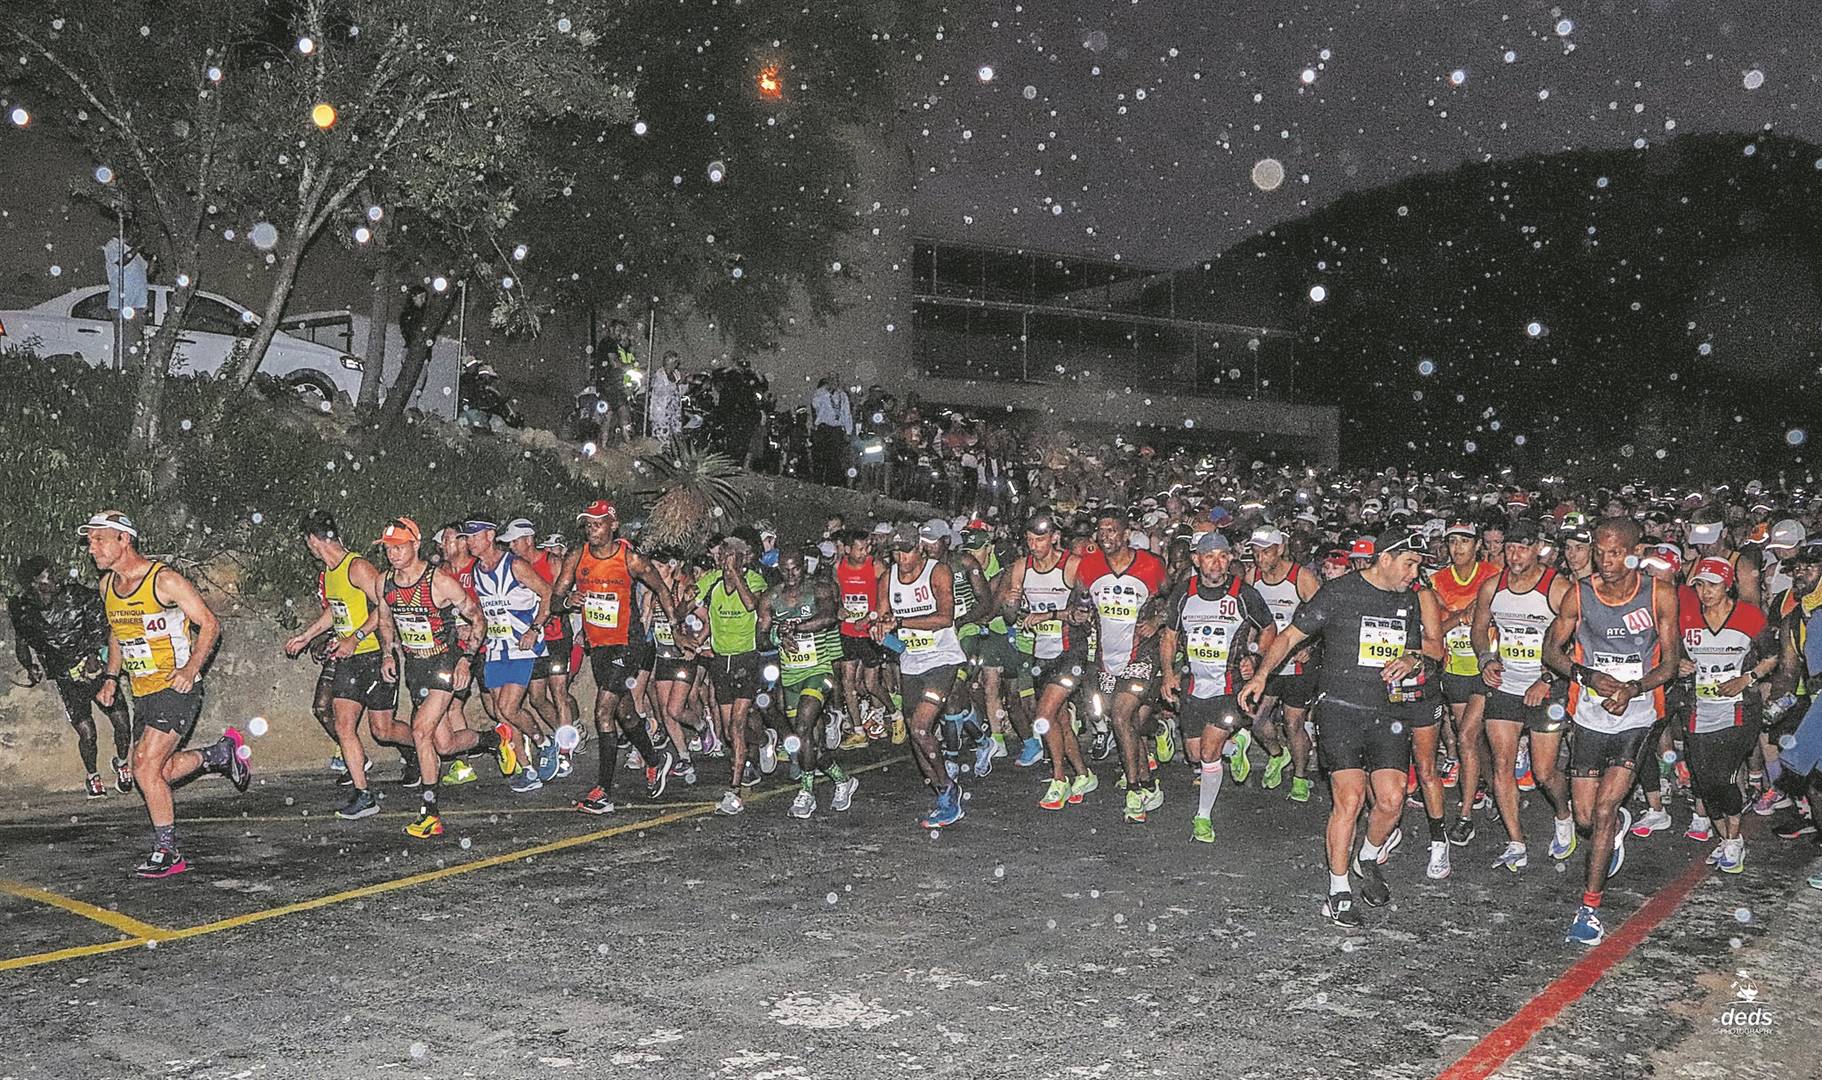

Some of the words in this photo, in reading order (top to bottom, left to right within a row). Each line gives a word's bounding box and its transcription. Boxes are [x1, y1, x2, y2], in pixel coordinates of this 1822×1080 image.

[914, 585, 929, 603] 50
[1103, 606, 1130, 616] 2150
[1220, 600, 1237, 616] 50
[588, 610, 611, 621] 1594
[1628, 609, 1651, 632] 40
[146, 617, 167, 632] 40
[403, 632, 427, 642] 1724
[1606, 628, 1626, 636] ATC
[1686, 629, 1702, 646] 45
[904, 638, 928, 648] 2130
[1193, 648, 1220, 658] 1658
[1369, 645, 1399, 658] 1994
[1505, 647, 1535, 658] 1918
[1702, 686, 1717, 696] 21
